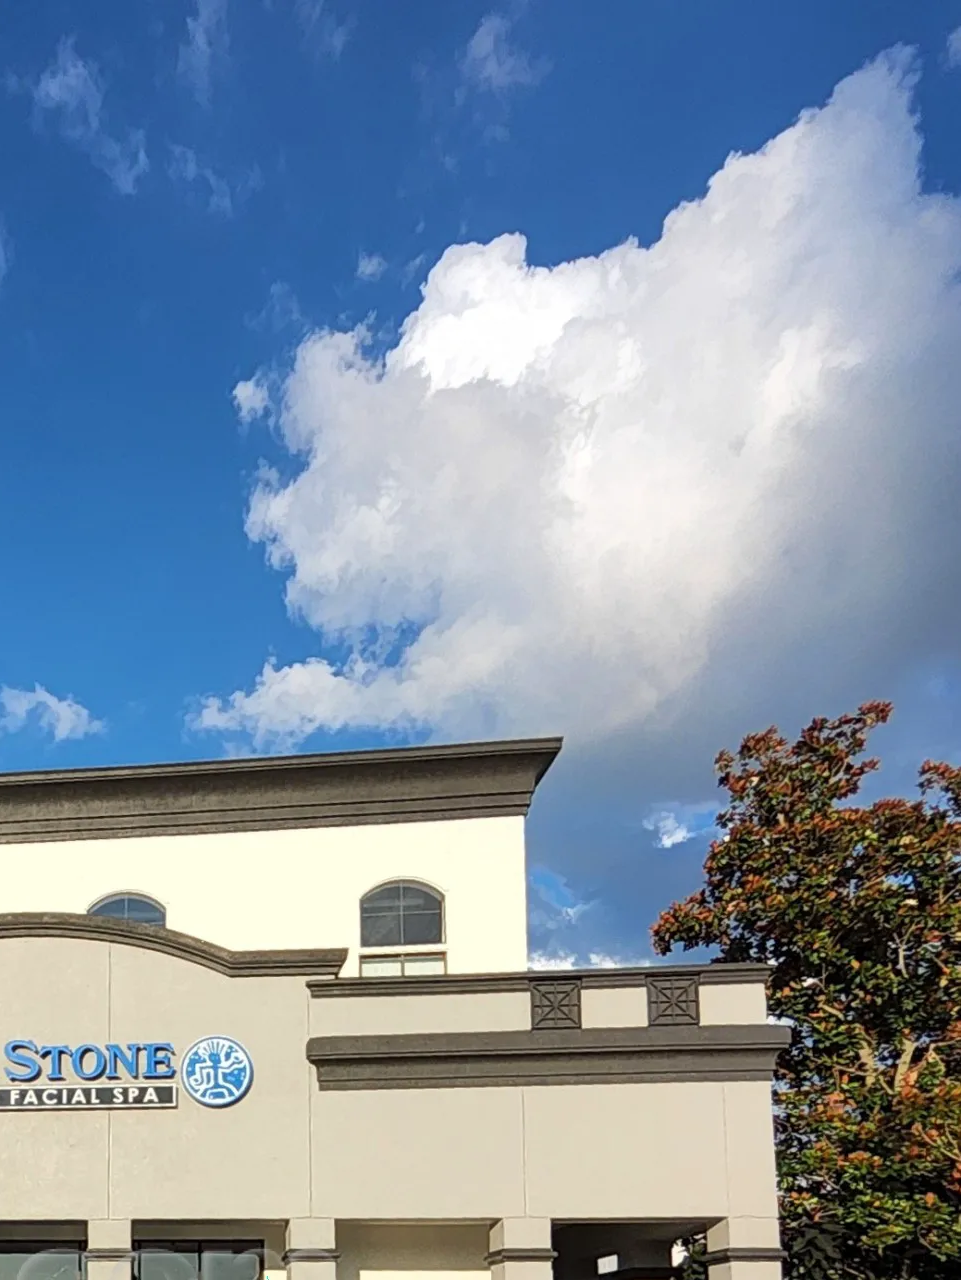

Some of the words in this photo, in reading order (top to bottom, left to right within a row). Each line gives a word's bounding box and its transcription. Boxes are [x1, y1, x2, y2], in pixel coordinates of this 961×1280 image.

[3, 1039, 176, 1083] STONE
[9, 1089, 100, 1106] FACIAL
[112, 1086, 160, 1104] SPA
